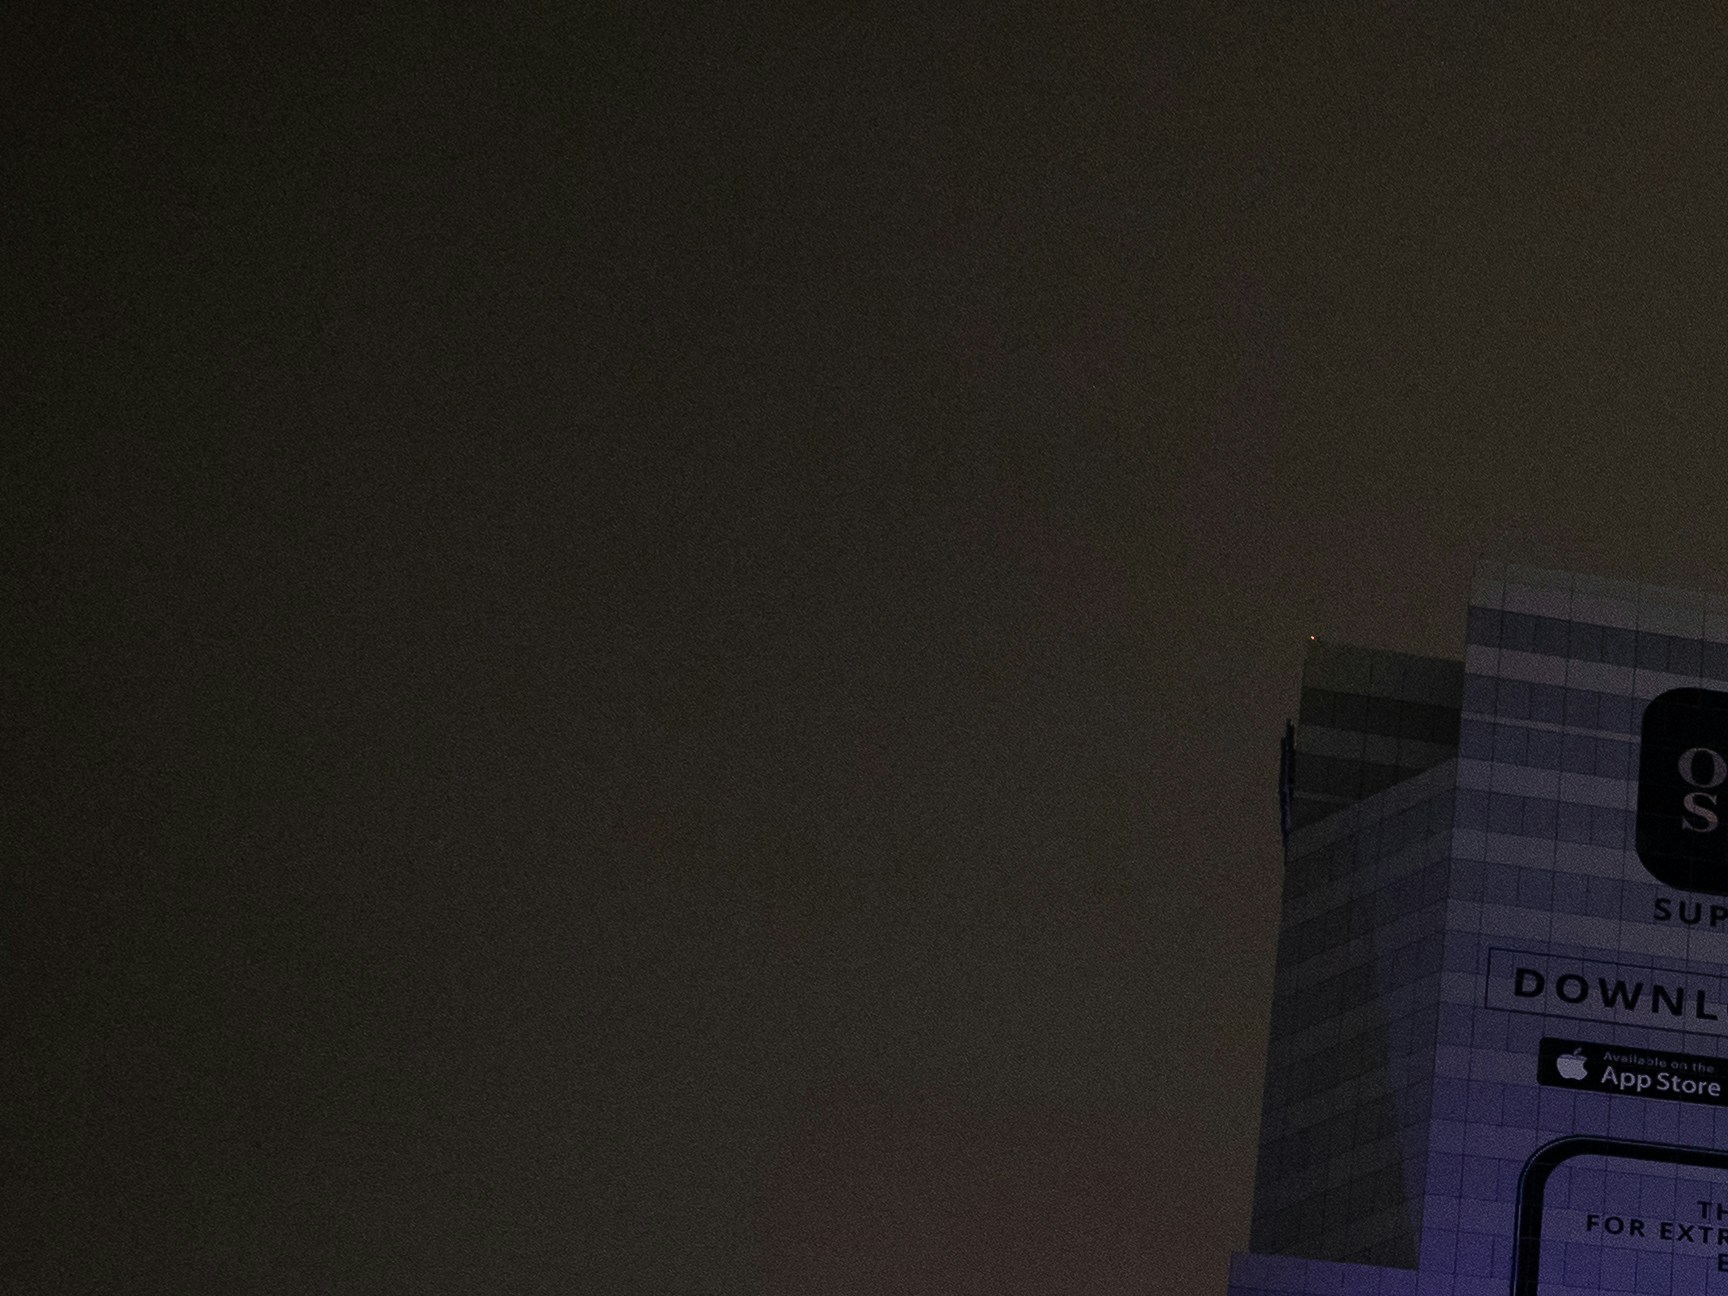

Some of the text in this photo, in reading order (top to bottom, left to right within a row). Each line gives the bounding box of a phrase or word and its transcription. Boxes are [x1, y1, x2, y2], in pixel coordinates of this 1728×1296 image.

[1603, 1051, 1716, 1074] Available on the
[1600, 1065, 1722, 1098] App Store
[1586, 1214, 1645, 1238] FOR
